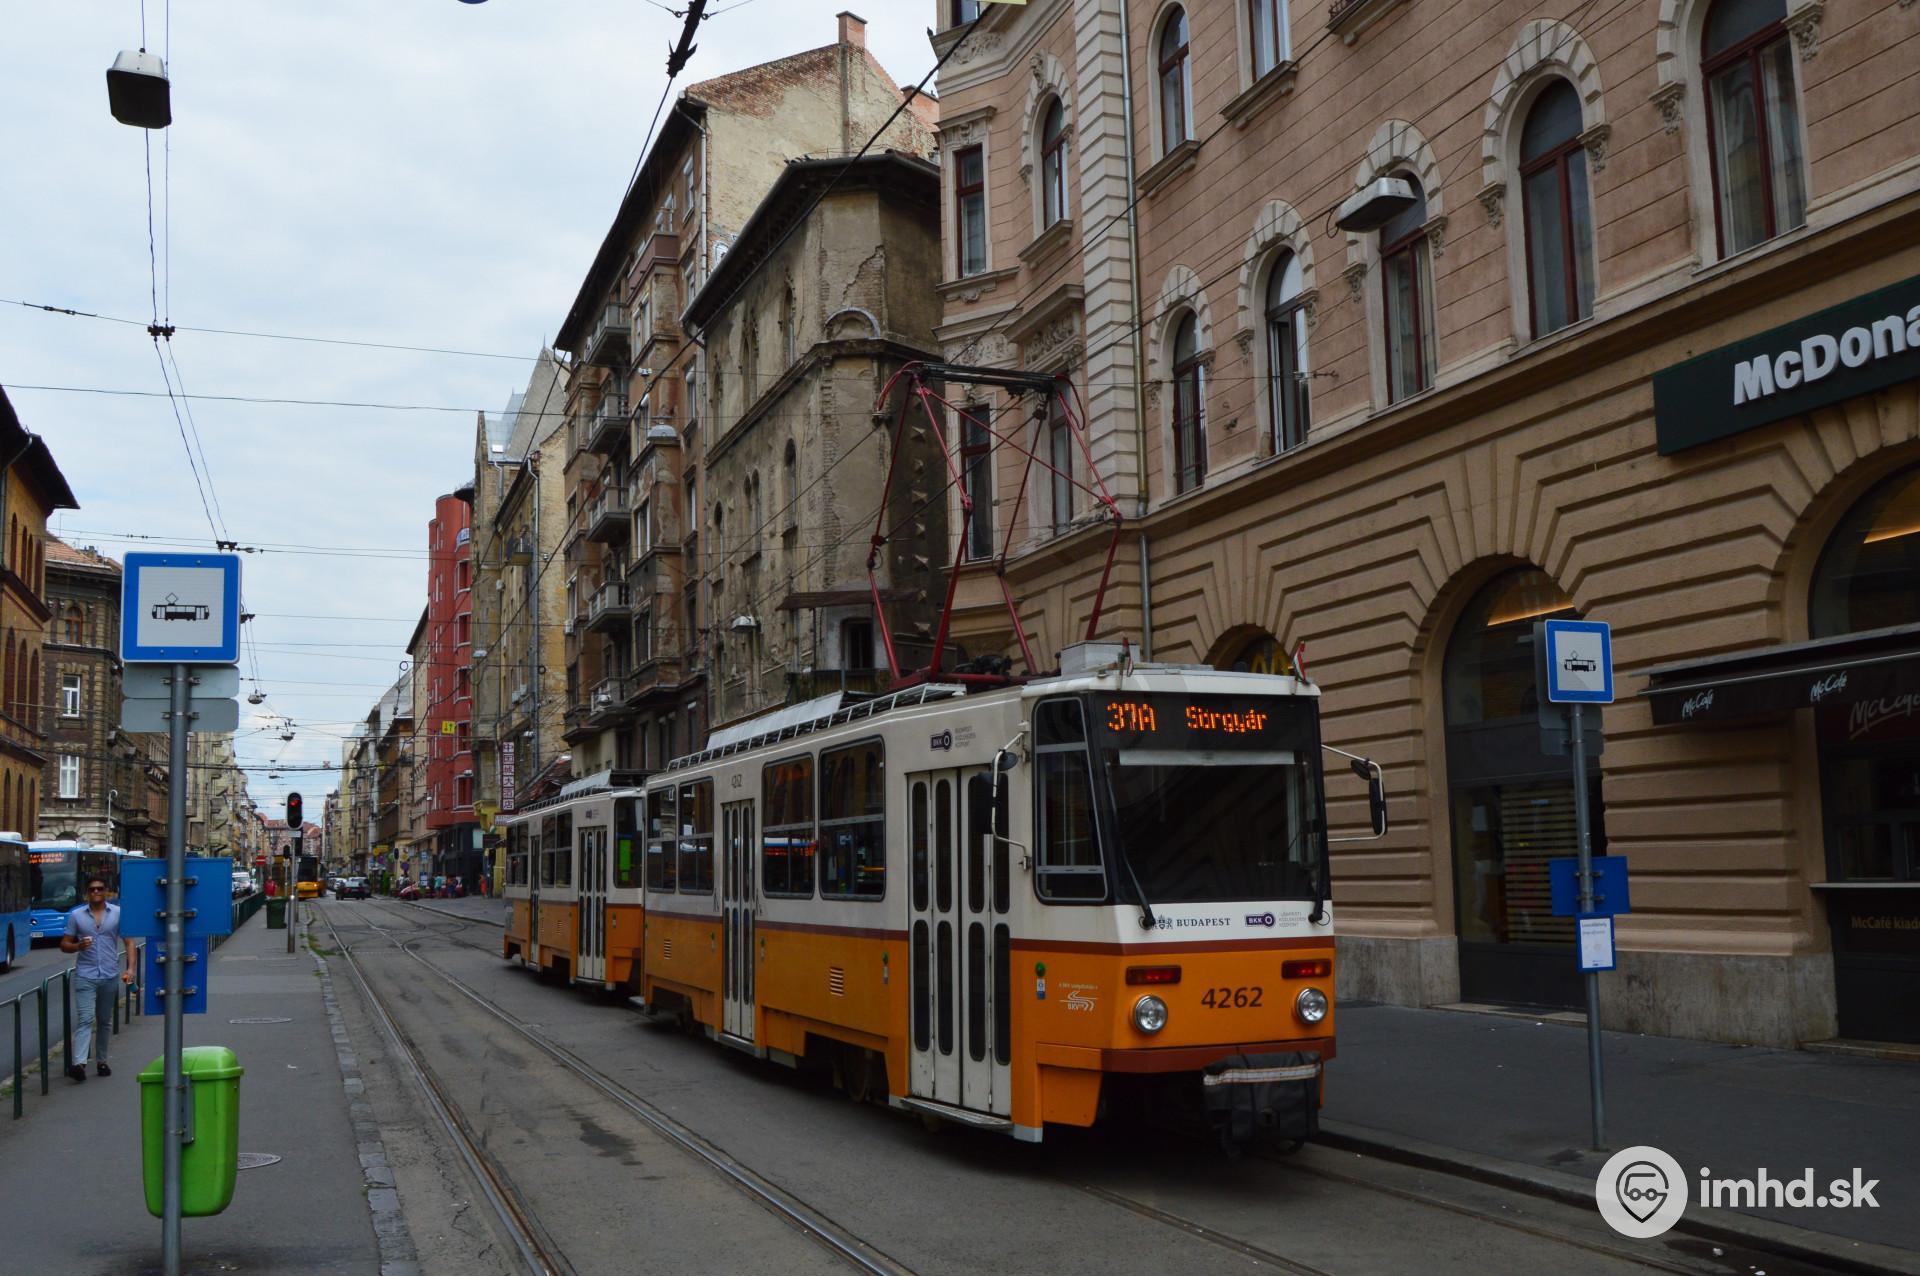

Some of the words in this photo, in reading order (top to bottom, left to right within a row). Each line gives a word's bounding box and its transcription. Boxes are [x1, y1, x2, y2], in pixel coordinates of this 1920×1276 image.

[1107, 702, 1156, 731] 37A
[1185, 704, 1267, 733] Sörgyár
[1176, 917, 1231, 927] BUDAPEST
[1201, 986, 1263, 1008] 4262
